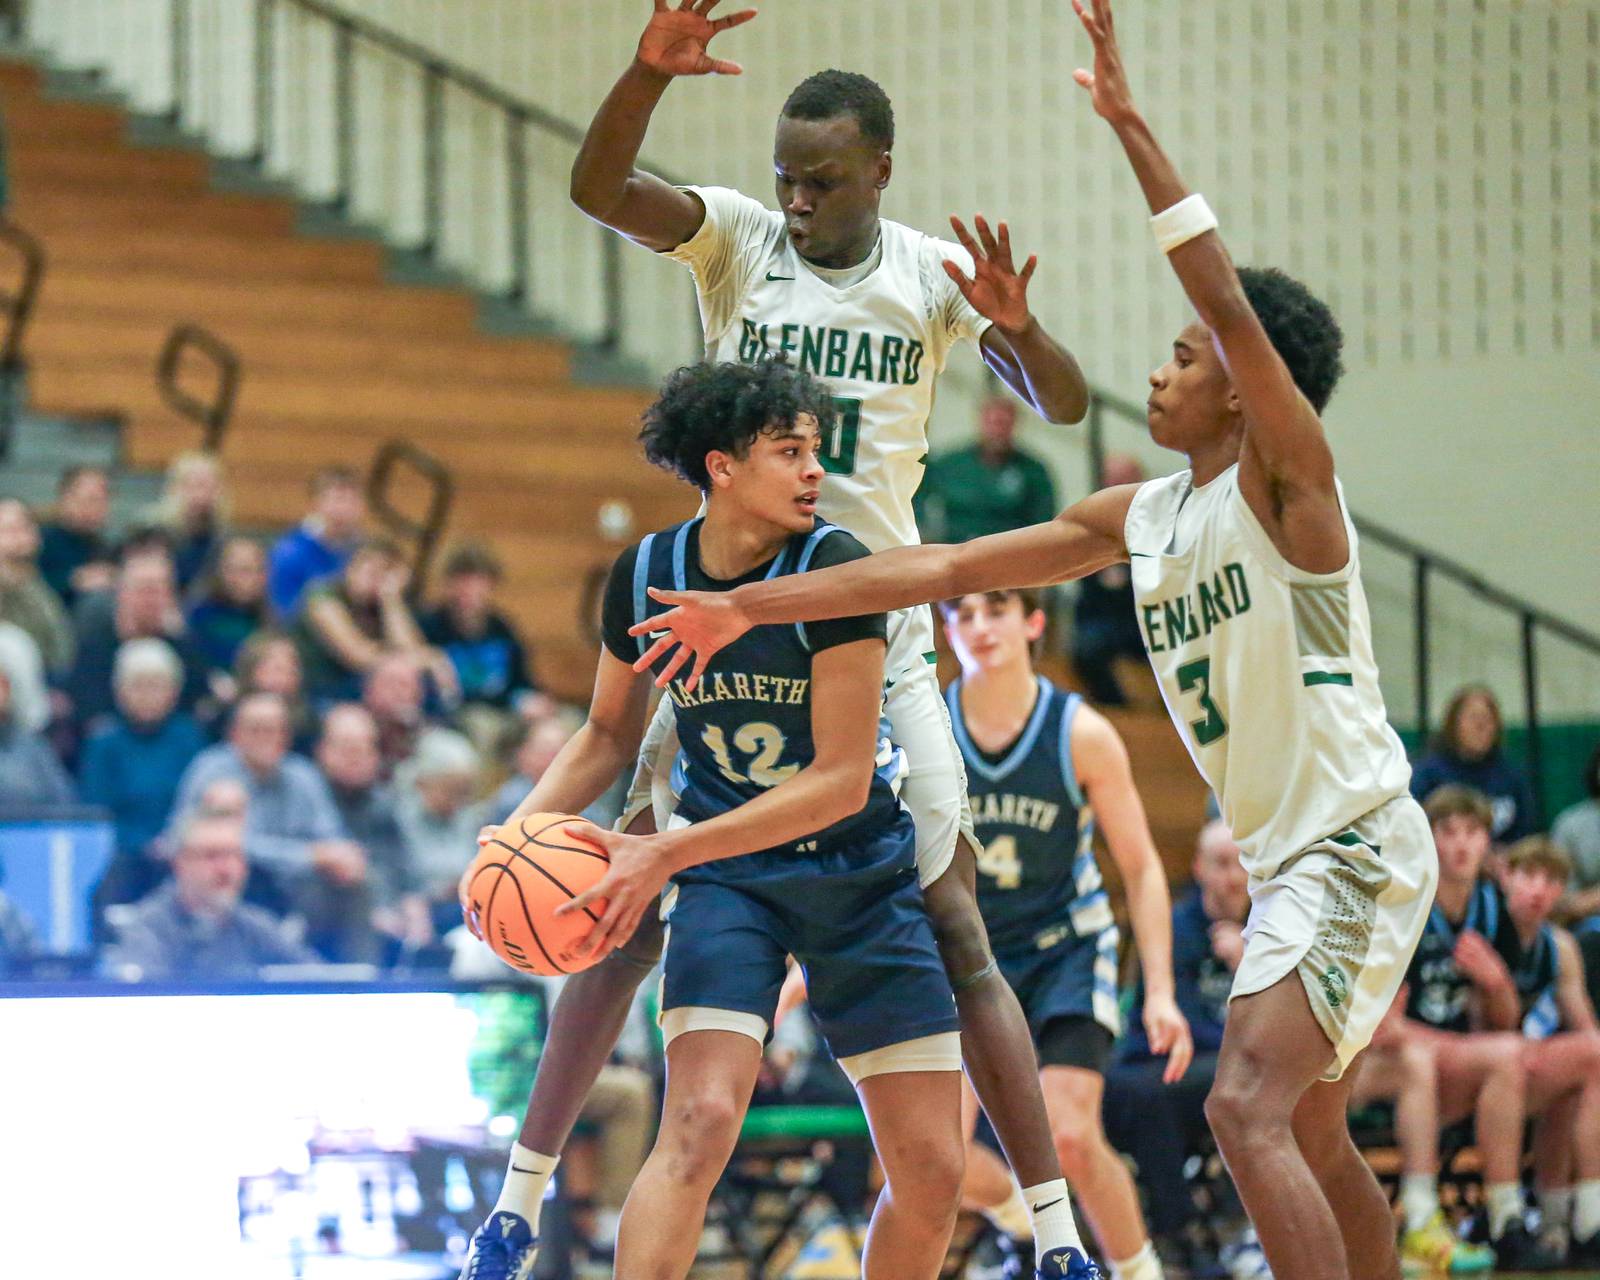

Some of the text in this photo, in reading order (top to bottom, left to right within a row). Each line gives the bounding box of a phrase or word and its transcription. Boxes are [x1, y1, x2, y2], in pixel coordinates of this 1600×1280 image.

[738, 317, 924, 385] GLENBARD
[1142, 562, 1251, 653] ENBARD
[1176, 655, 1230, 747] 3
[701, 722, 801, 787] 12
[976, 834, 1022, 889] 4
